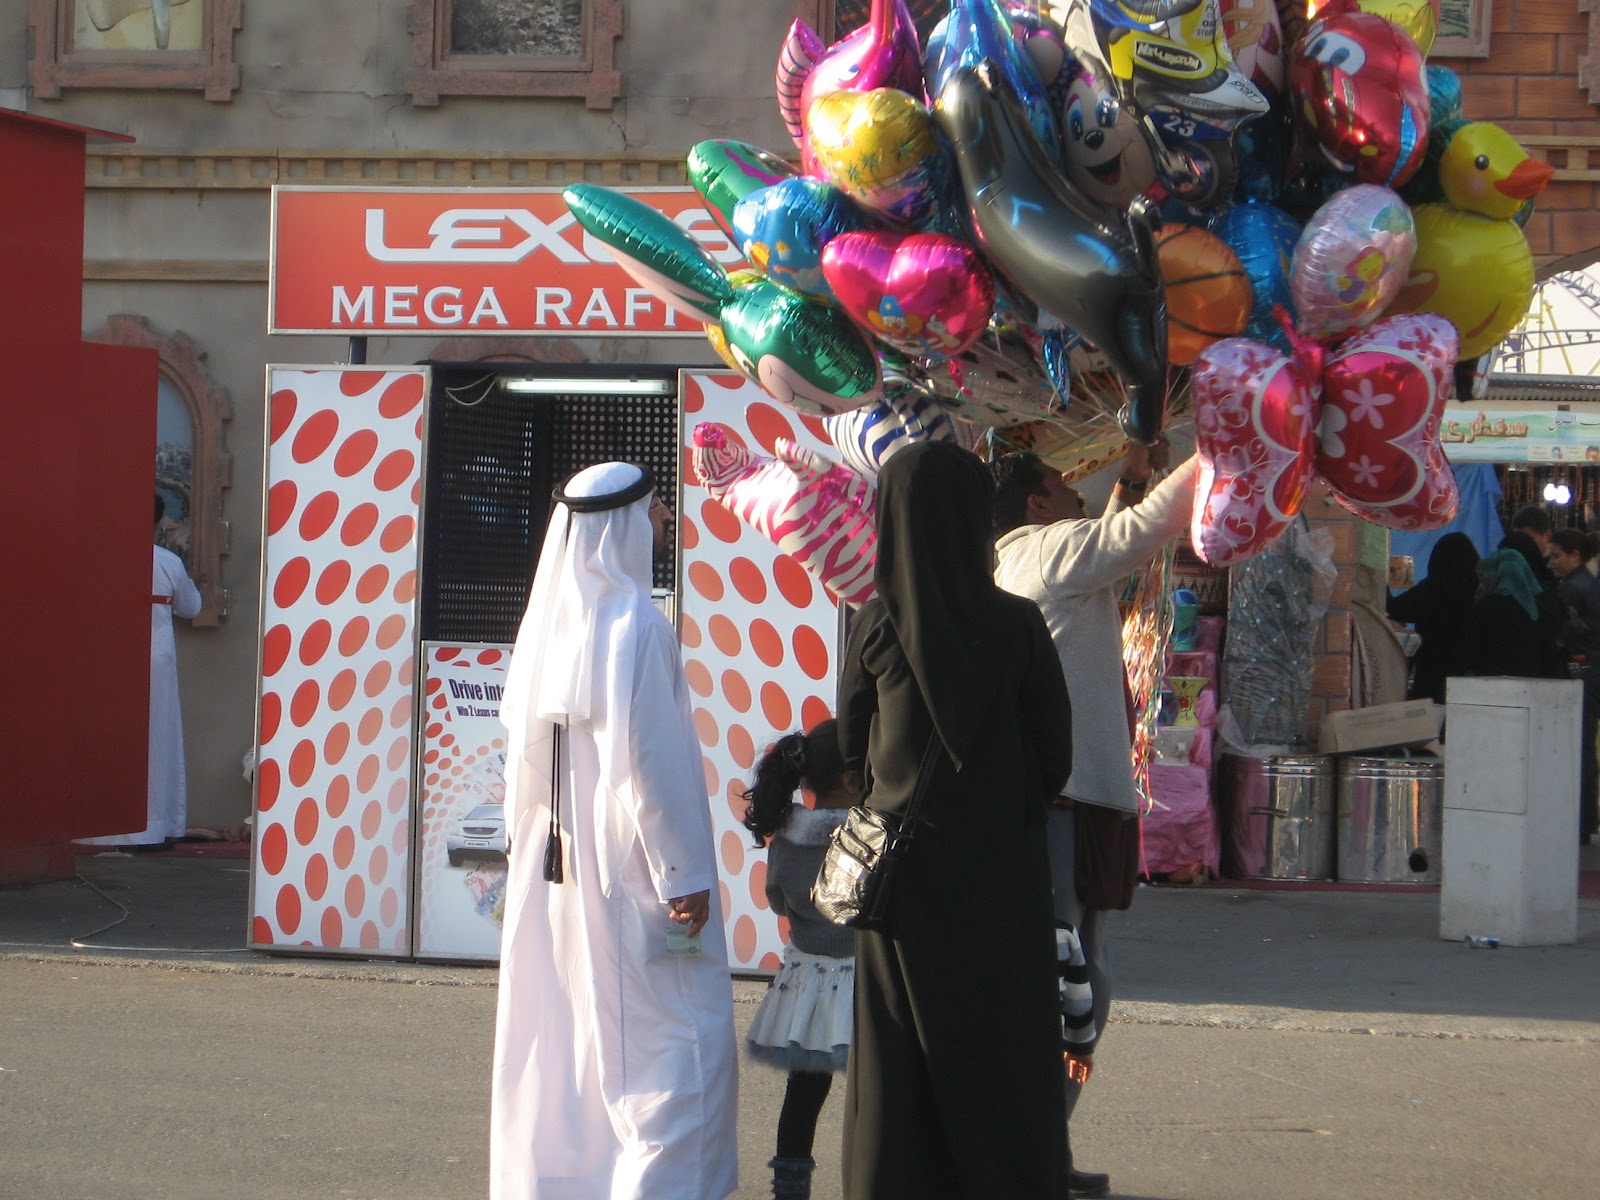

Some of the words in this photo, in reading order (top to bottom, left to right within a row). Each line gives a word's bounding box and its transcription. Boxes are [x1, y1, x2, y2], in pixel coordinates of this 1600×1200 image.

[1163, 115, 1197, 137] 23
[365, 208, 746, 264] LEXS
[331, 286, 509, 326] MEGA
[448, 679, 484, 701] Drive
[468, 704, 475, 717] 2
[473, 707, 491, 717] Lexus
